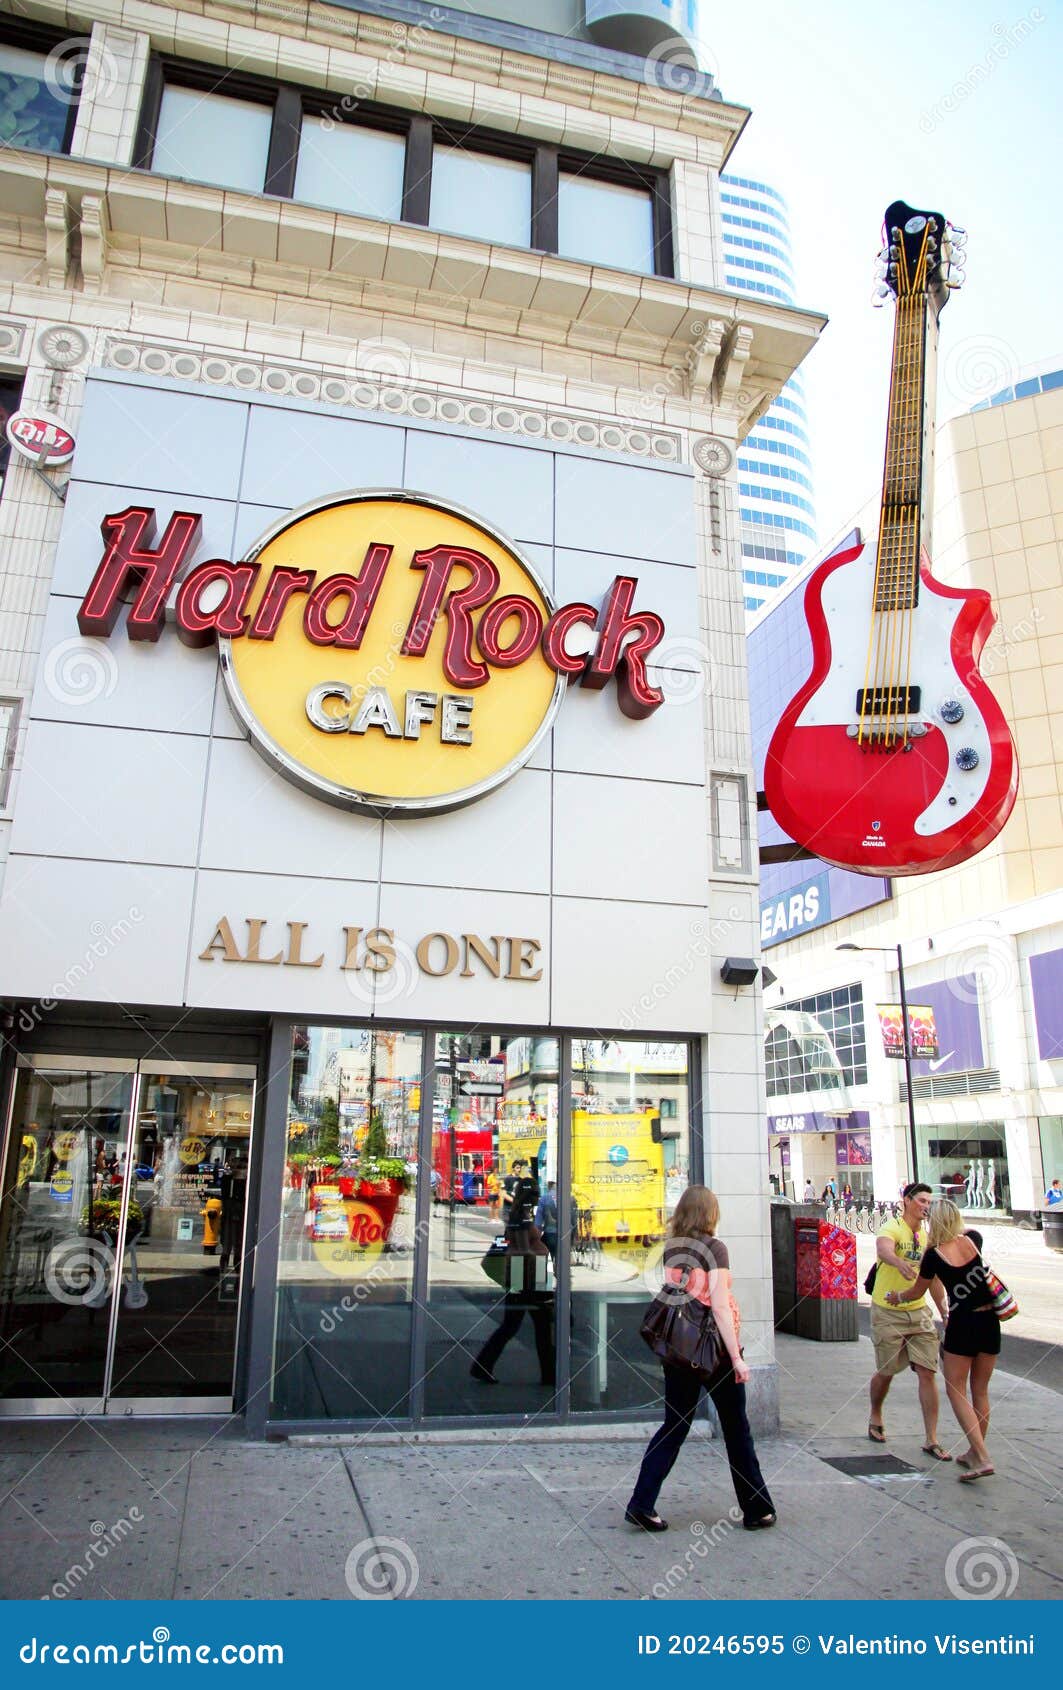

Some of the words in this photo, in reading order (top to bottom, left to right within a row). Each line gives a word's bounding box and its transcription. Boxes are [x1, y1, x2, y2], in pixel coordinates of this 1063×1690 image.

[77, 505, 394, 650] Hard
[400, 544, 665, 720] Rock
[305, 681, 474, 747] CAFE
[198, 915, 325, 968] ALL
[340, 926, 397, 972] IS
[416, 932, 544, 982] ONE
[775, 1116, 805, 1132] SEARS
[331, 1250, 365, 1261] CAFE
